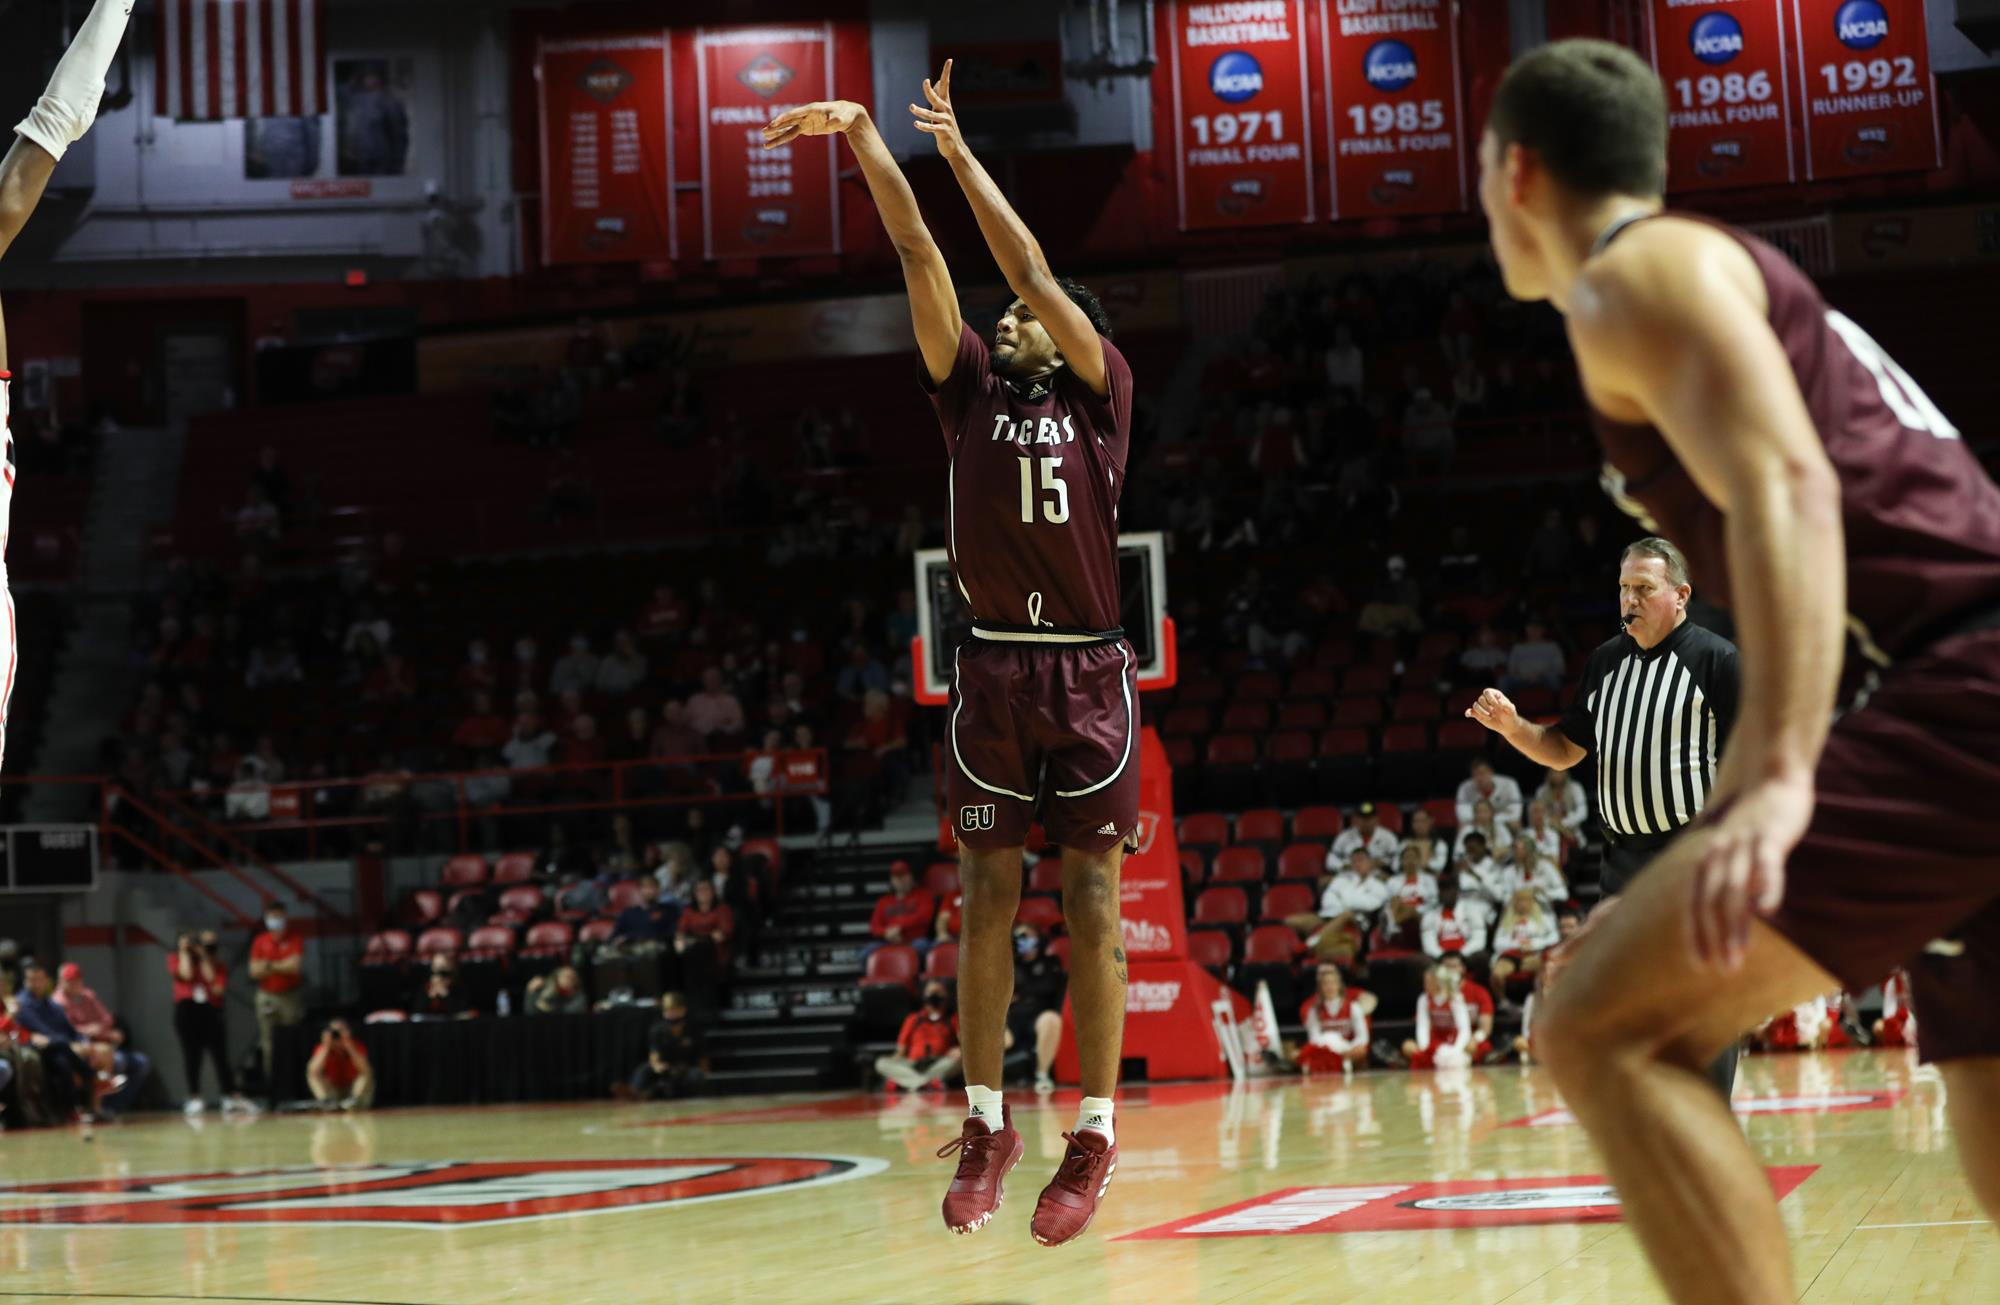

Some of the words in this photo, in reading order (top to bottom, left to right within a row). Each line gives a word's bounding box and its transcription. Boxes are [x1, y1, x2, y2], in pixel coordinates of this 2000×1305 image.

[1188, 1, 1286, 24] HILLTOPPER
[1341, 11, 1438, 36] BASKETBALL
[1186, 21, 1291, 47] BASKETBALL
[1839, 19, 1889, 40] NCAA
[1694, 33, 1743, 56] NCAA
[1212, 73, 1263, 94] NCAA
[1367, 62, 1417, 82] NCAA
[1820, 56, 1917, 94] 1992
[1674, 69, 1772, 108] 1986
[1812, 88, 1924, 116] RUNNER-UP
[710, 105, 765, 126] FINAL
[1191, 110, 1284, 146] 1971
[1347, 100, 1444, 135] 1985
[1668, 107, 1723, 129] FINAL
[1725, 102, 1778, 124] FOUR
[1188, 146, 1244, 166] FINAL
[1247, 142, 1300, 162] FOUR
[1340, 137, 1395, 156] FINAL
[1399, 132, 1452, 151] FOUR
[992, 414, 1075, 446] TIGERS
[1017, 456, 1070, 524] 15
[960, 804, 995, 831] CU
